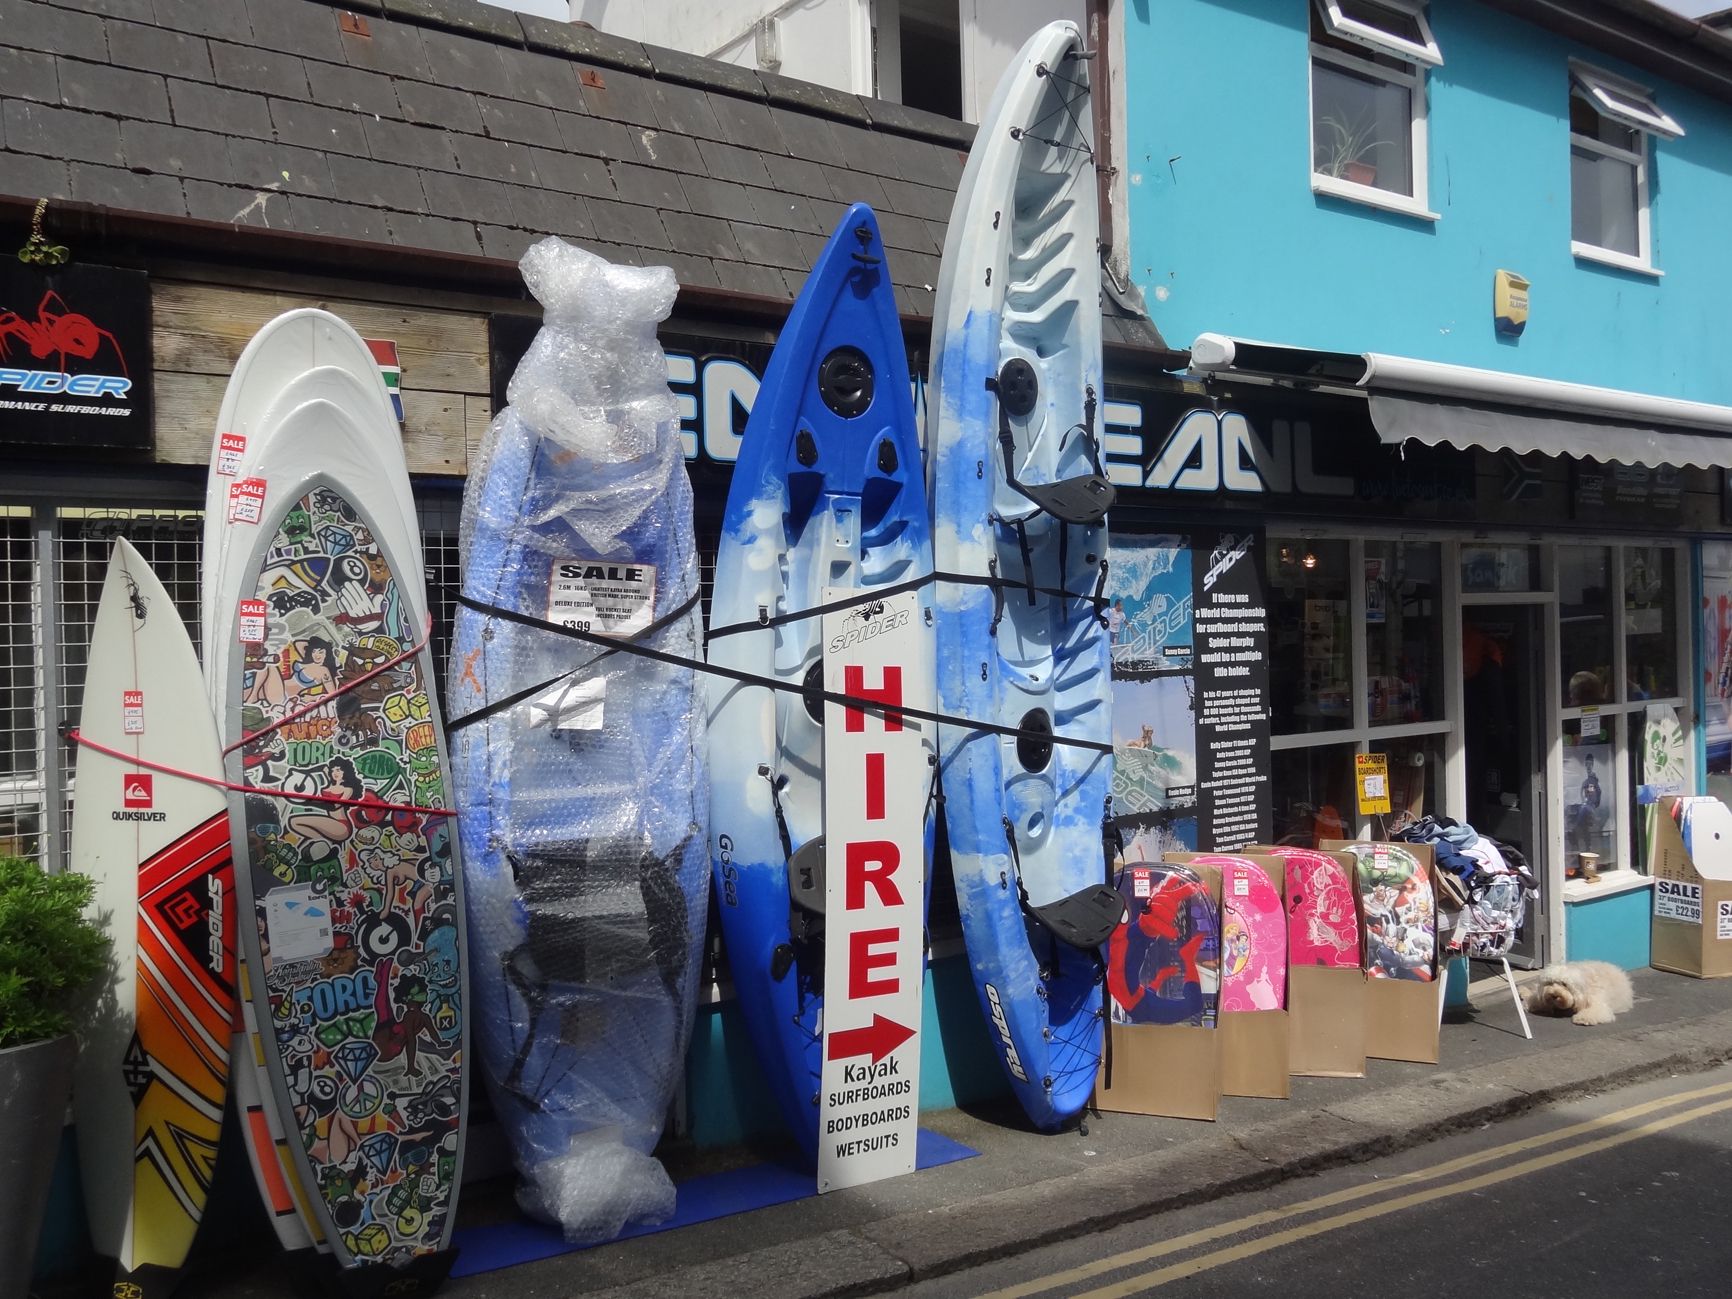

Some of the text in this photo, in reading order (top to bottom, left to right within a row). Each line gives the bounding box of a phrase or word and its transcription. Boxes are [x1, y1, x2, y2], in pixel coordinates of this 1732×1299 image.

[49, 404, 132, 416] SURFBOARDS
[222, 439, 244, 449] SALE
[242, 484, 264, 495] SALE
[1203, 533, 1255, 593] SPIDER
[560, 565, 643, 582] SALE
[1218, 593, 1235, 603] there
[1236, 594, 1249, 602] was
[241, 604, 264, 614] SALE
[1195, 607, 1265, 618] a World Championship
[829, 609, 910, 654] SPIDER
[1196, 622, 1265, 633] for surfboard shapers,
[1209, 637, 1254, 648] Spider Murphy
[1201, 651, 1262, 662] would be a multiple
[1214, 667, 1227, 677] title
[125, 695, 142, 704] SALE
[1364, 755, 1385, 764] SPIDER
[112, 811, 167, 822] QUIKSILVER
[844, 665, 904, 1000] HIRE
[1658, 881, 1700, 899] SALE
[1667, 897, 1700, 907] BODYBOARDS
[1675, 905, 1700, 919] £22.99
[208, 873, 224, 974] SPIDER
[844, 1055, 900, 1085] Kayak
[828, 1079, 911, 1108] SURFBOARDS
[827, 1105, 910, 1134] BODYBOARDS
[836, 1132, 899, 1159] WETSUITS
